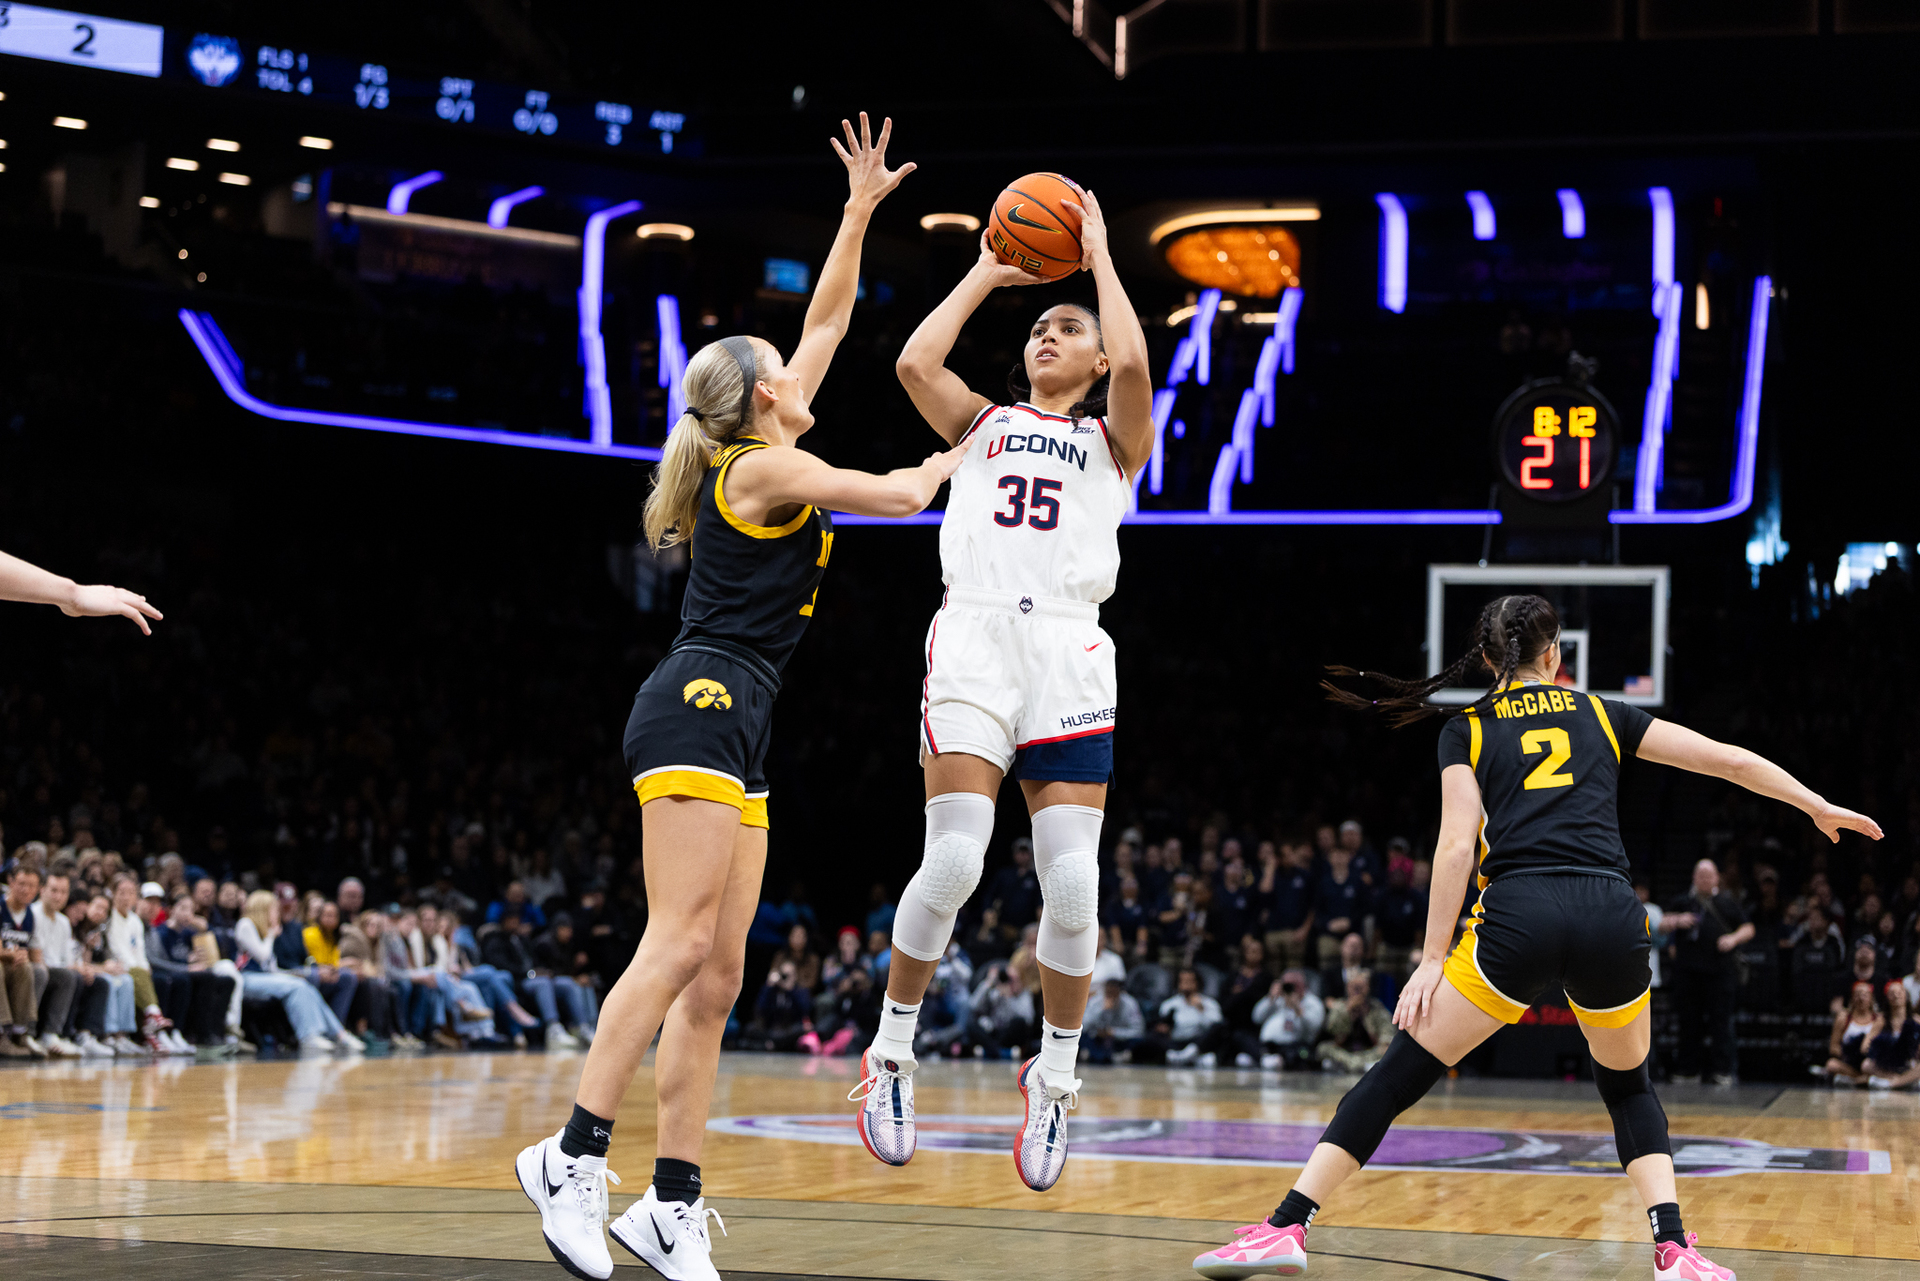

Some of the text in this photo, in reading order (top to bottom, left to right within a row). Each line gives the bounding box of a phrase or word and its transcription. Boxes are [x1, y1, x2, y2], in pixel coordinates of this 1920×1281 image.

[71, 24, 96, 56] 2
[993, 229, 1044, 273] ELITE
[1533, 406, 1597, 438] 8:12
[987, 434, 1088, 472] UCONN
[1521, 435, 1591, 489] 21
[994, 474, 1063, 532] 35
[1492, 690, 1577, 719] McCABE
[1520, 727, 1574, 791] 2
